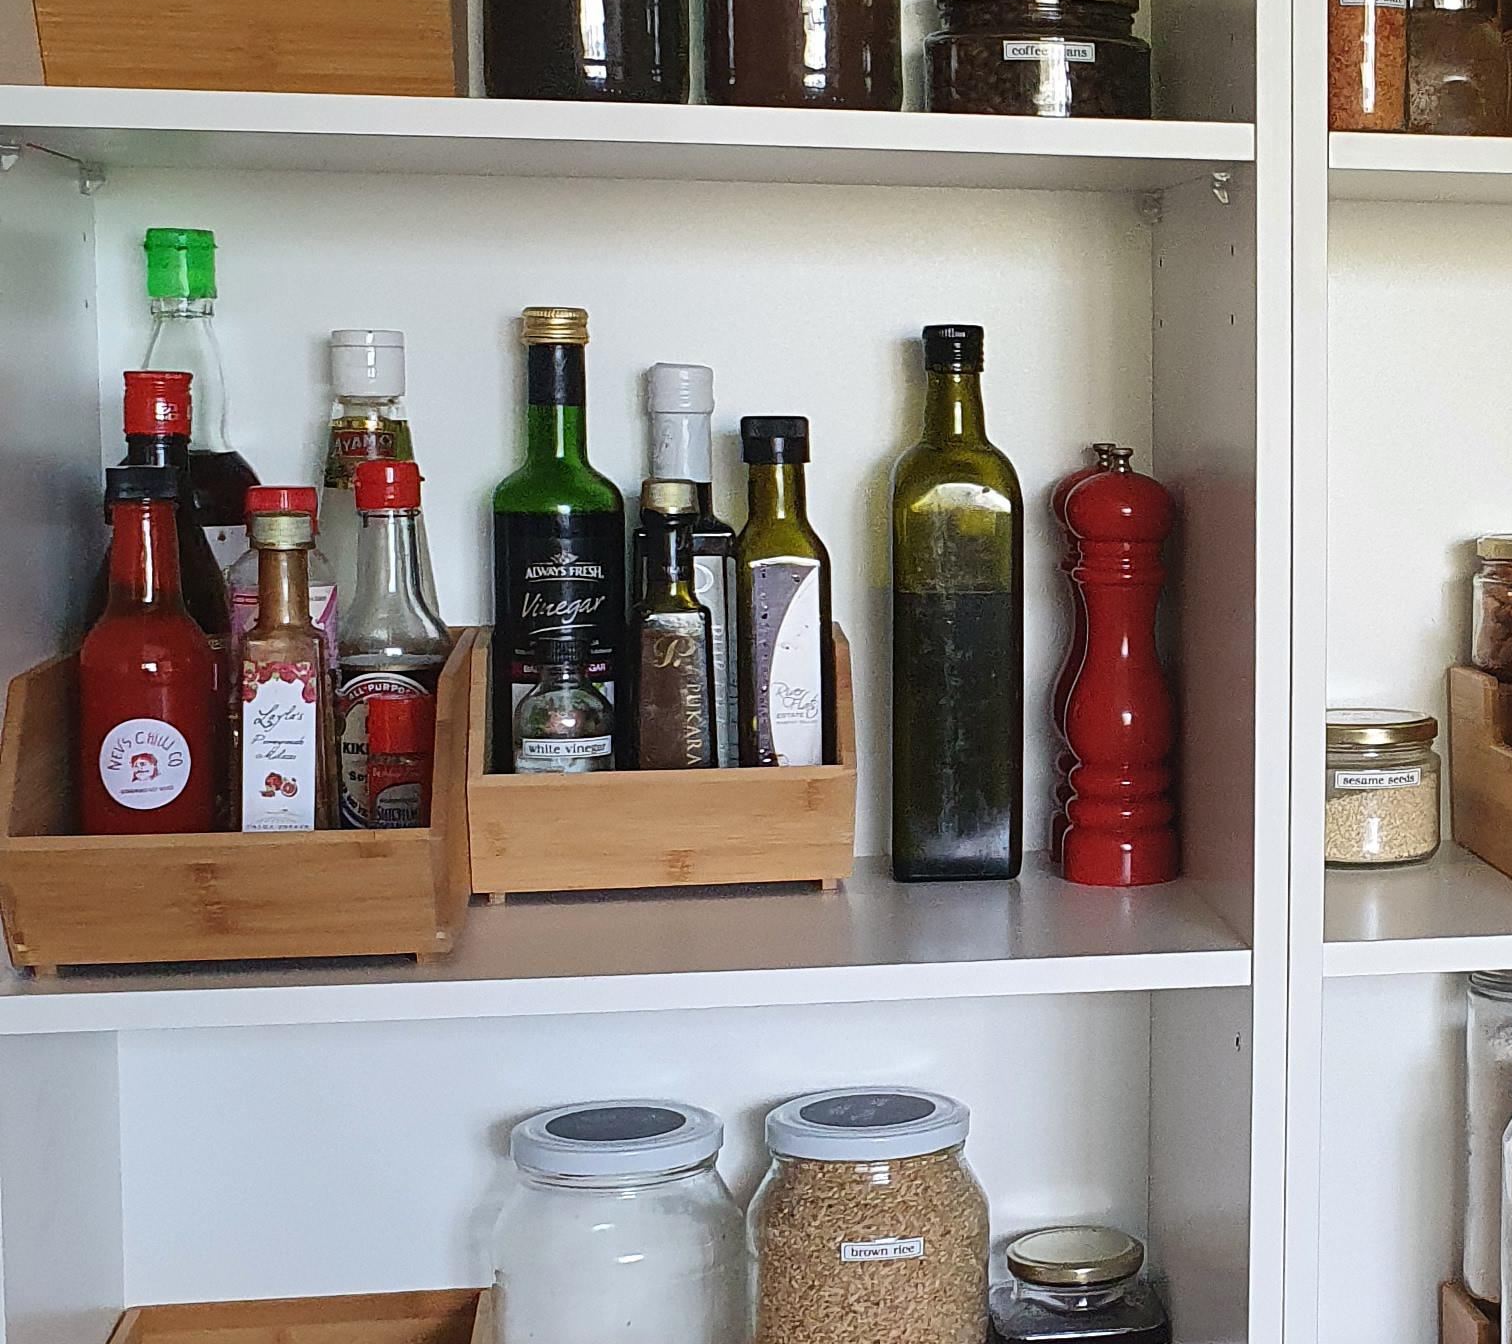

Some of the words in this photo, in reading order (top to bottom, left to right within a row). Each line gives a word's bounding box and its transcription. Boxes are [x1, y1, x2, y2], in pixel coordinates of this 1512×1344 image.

[1011, 45, 1047, 57] coffee
[521, 591, 607, 625] Vinegar
[686, 680, 704, 767] PUKARA
[528, 742, 562, 755] white
[565, 742, 607, 757] vinegar
[168, 751, 184, 768] CO
[1343, 774, 1384, 786] sesame
[1388, 772, 1415, 785] seeds
[850, 1245, 888, 1259] brown
[893, 1243, 915, 1256] rice
